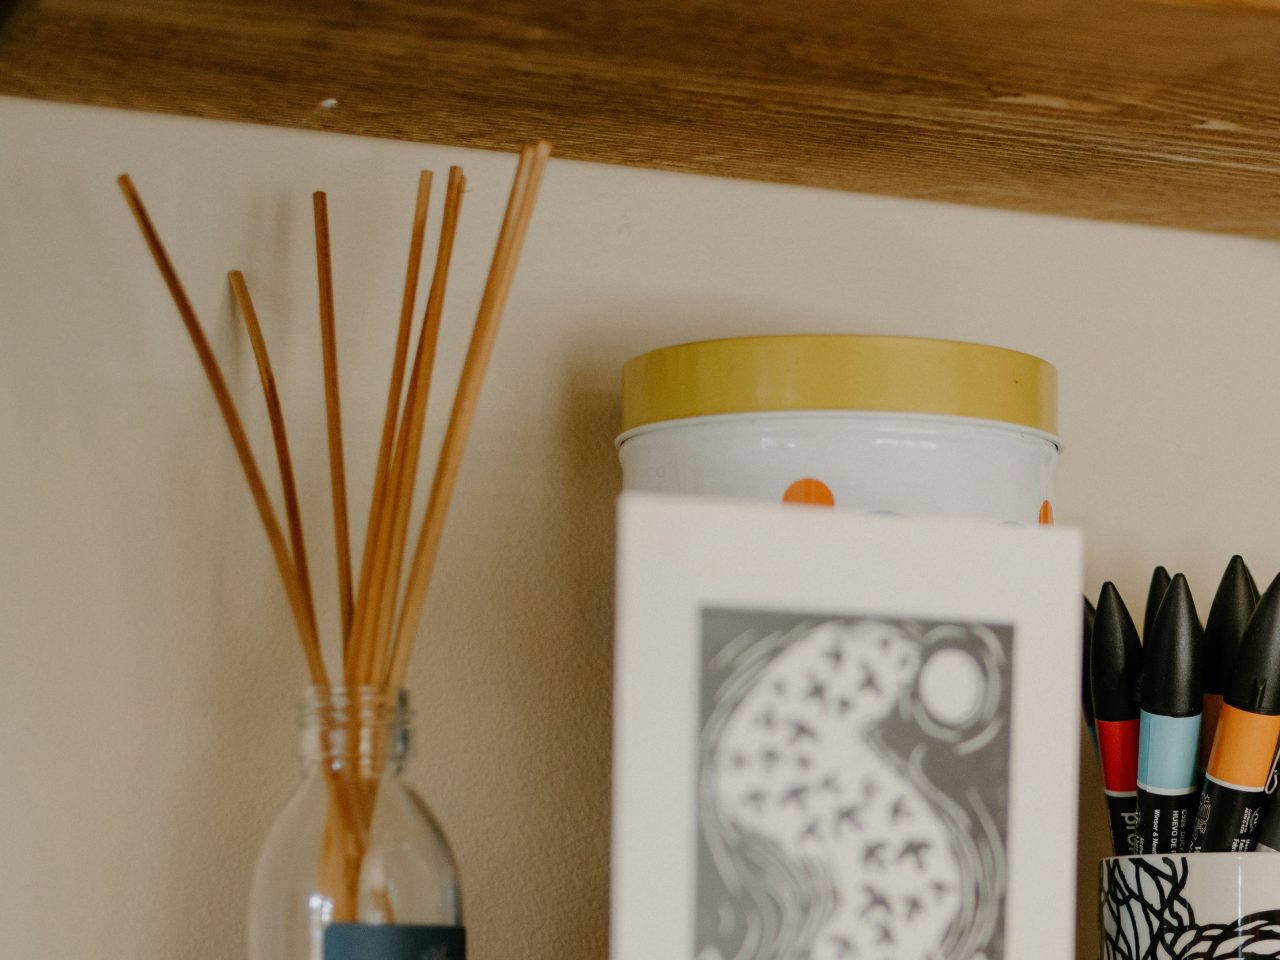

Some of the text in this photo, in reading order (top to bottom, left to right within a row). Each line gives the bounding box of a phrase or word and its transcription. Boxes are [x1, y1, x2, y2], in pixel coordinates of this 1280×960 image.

[1153, 809, 1161, 831] Winsor
[1171, 810, 1179, 837] HUEVO
[1170, 838, 1178, 849] DE
